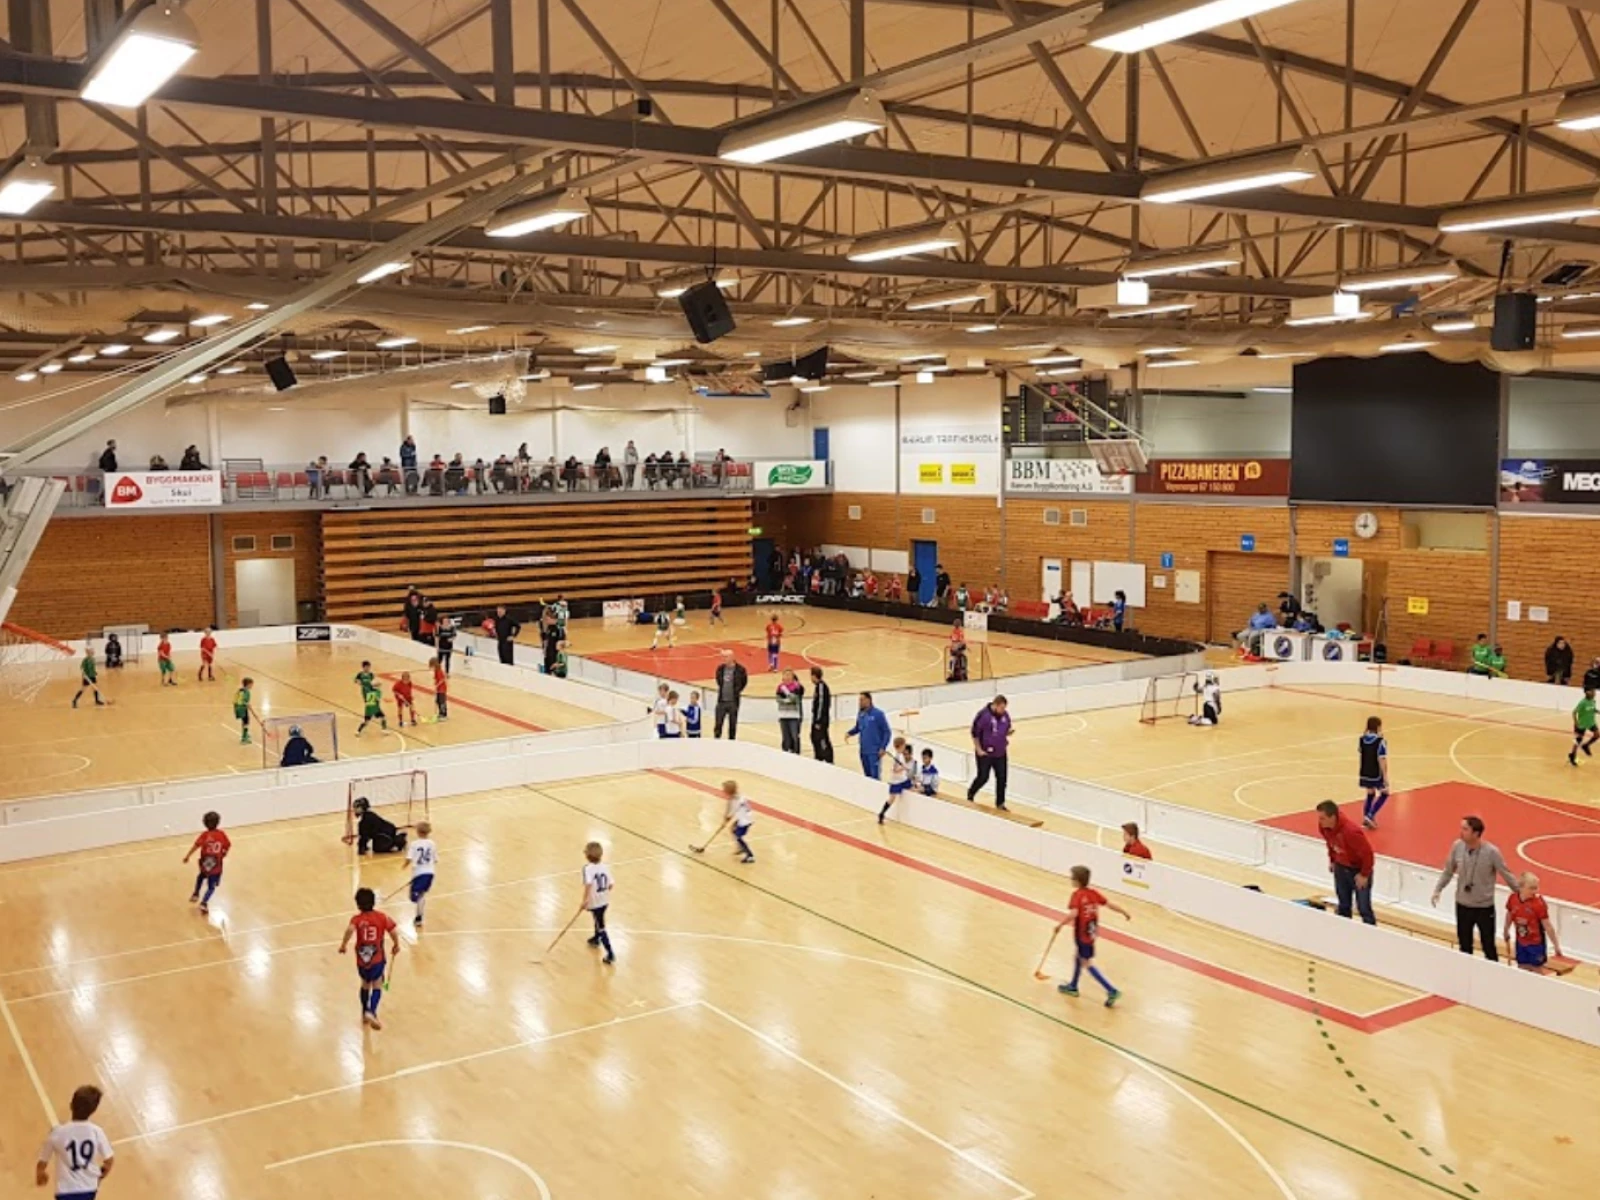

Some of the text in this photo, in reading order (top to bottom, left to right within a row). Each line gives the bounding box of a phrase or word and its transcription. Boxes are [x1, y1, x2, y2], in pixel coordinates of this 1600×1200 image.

[1012, 460, 1051, 479] BBM
[146, 475, 214, 485] BYGGMAKKER
[116, 485, 138, 497] BM
[361, 926, 377, 941] 13
[65, 1139, 95, 1172] 19
